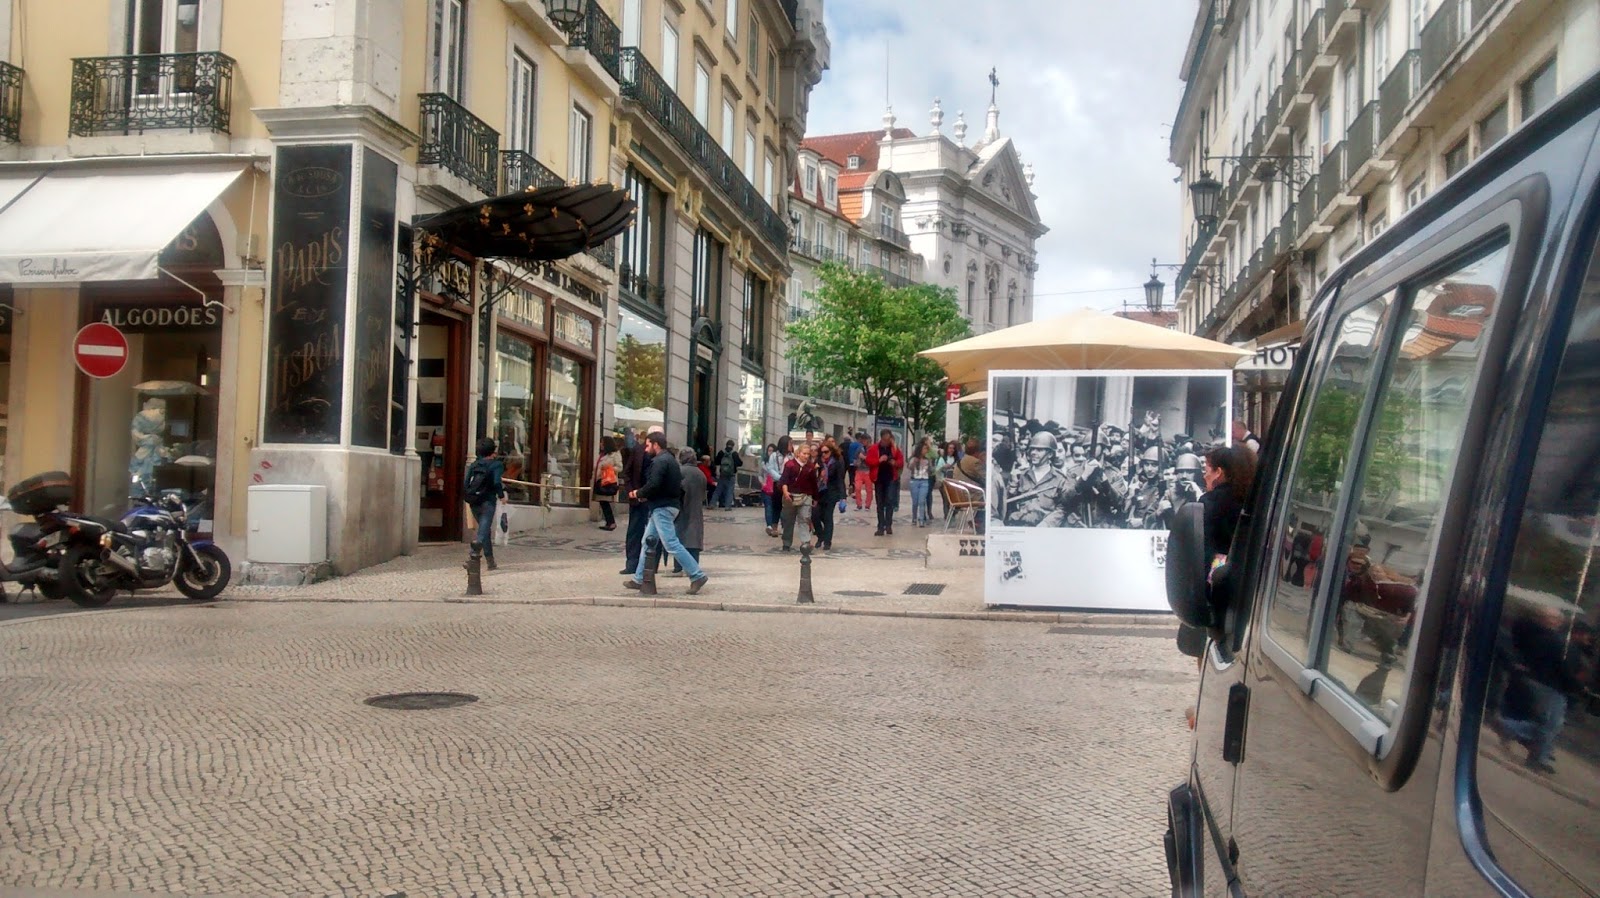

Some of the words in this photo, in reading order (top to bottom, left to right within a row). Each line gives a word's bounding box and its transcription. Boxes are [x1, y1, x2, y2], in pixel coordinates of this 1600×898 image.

[277, 226, 343, 313] PARIS
[101, 305, 217, 326] ALGODÕES
[271, 323, 341, 413] LISBOA
